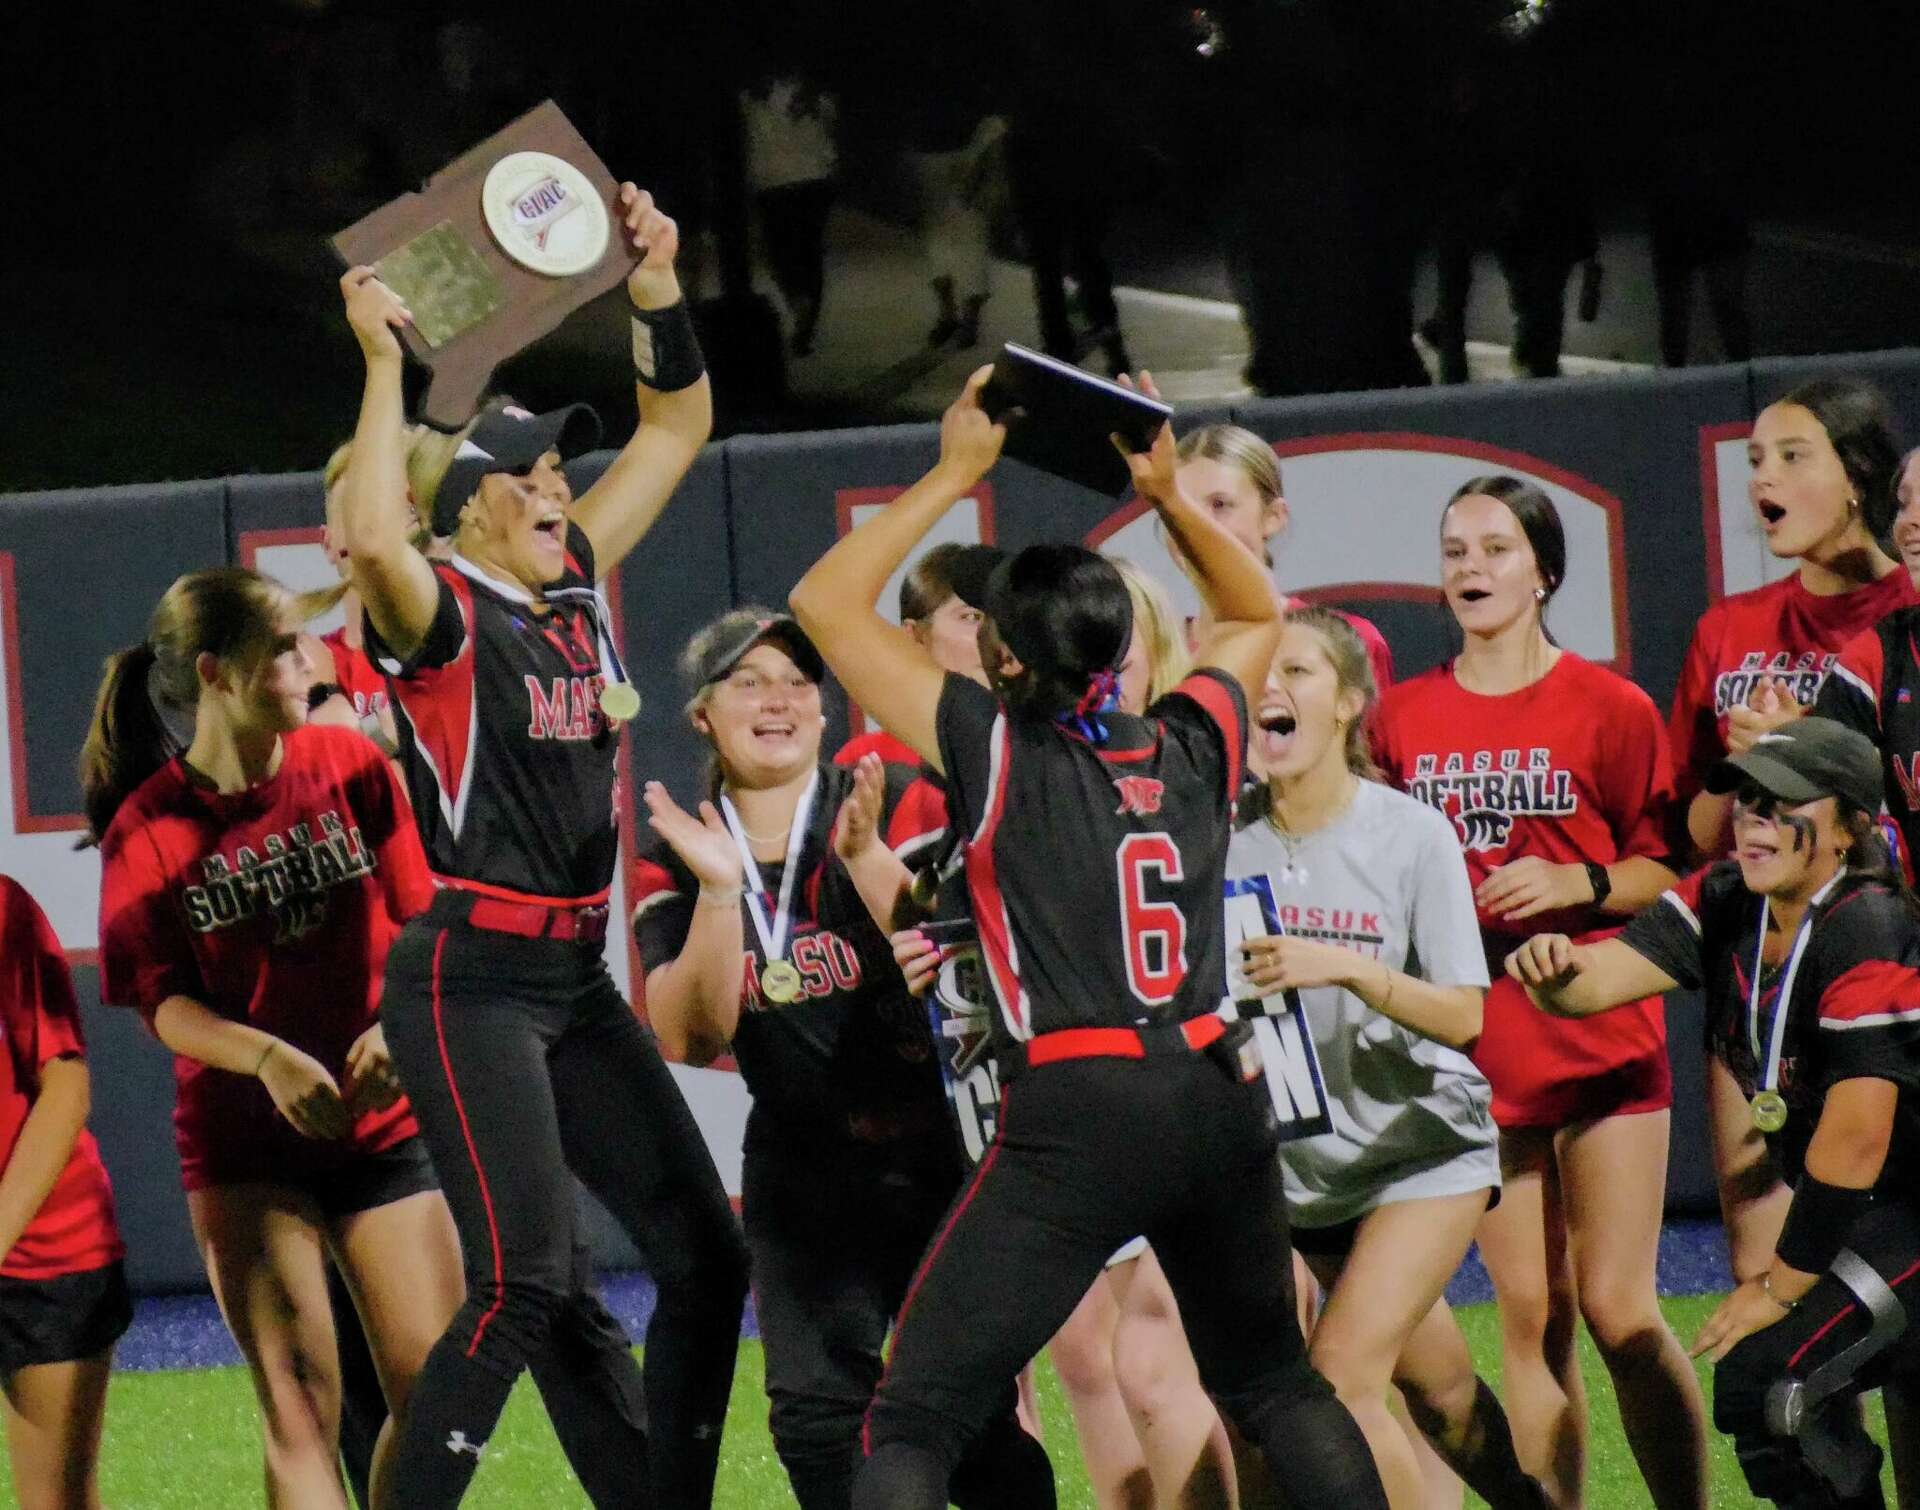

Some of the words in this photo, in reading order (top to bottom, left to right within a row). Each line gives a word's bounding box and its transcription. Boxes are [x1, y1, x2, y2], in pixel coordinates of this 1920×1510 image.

[1738, 651, 1838, 674] MASU
[1416, 747, 1552, 778] MASUK
[1406, 769, 1579, 817] OFTBALL
[1116, 832, 1189, 1007] 6
[1279, 904, 1379, 933] ASUK
